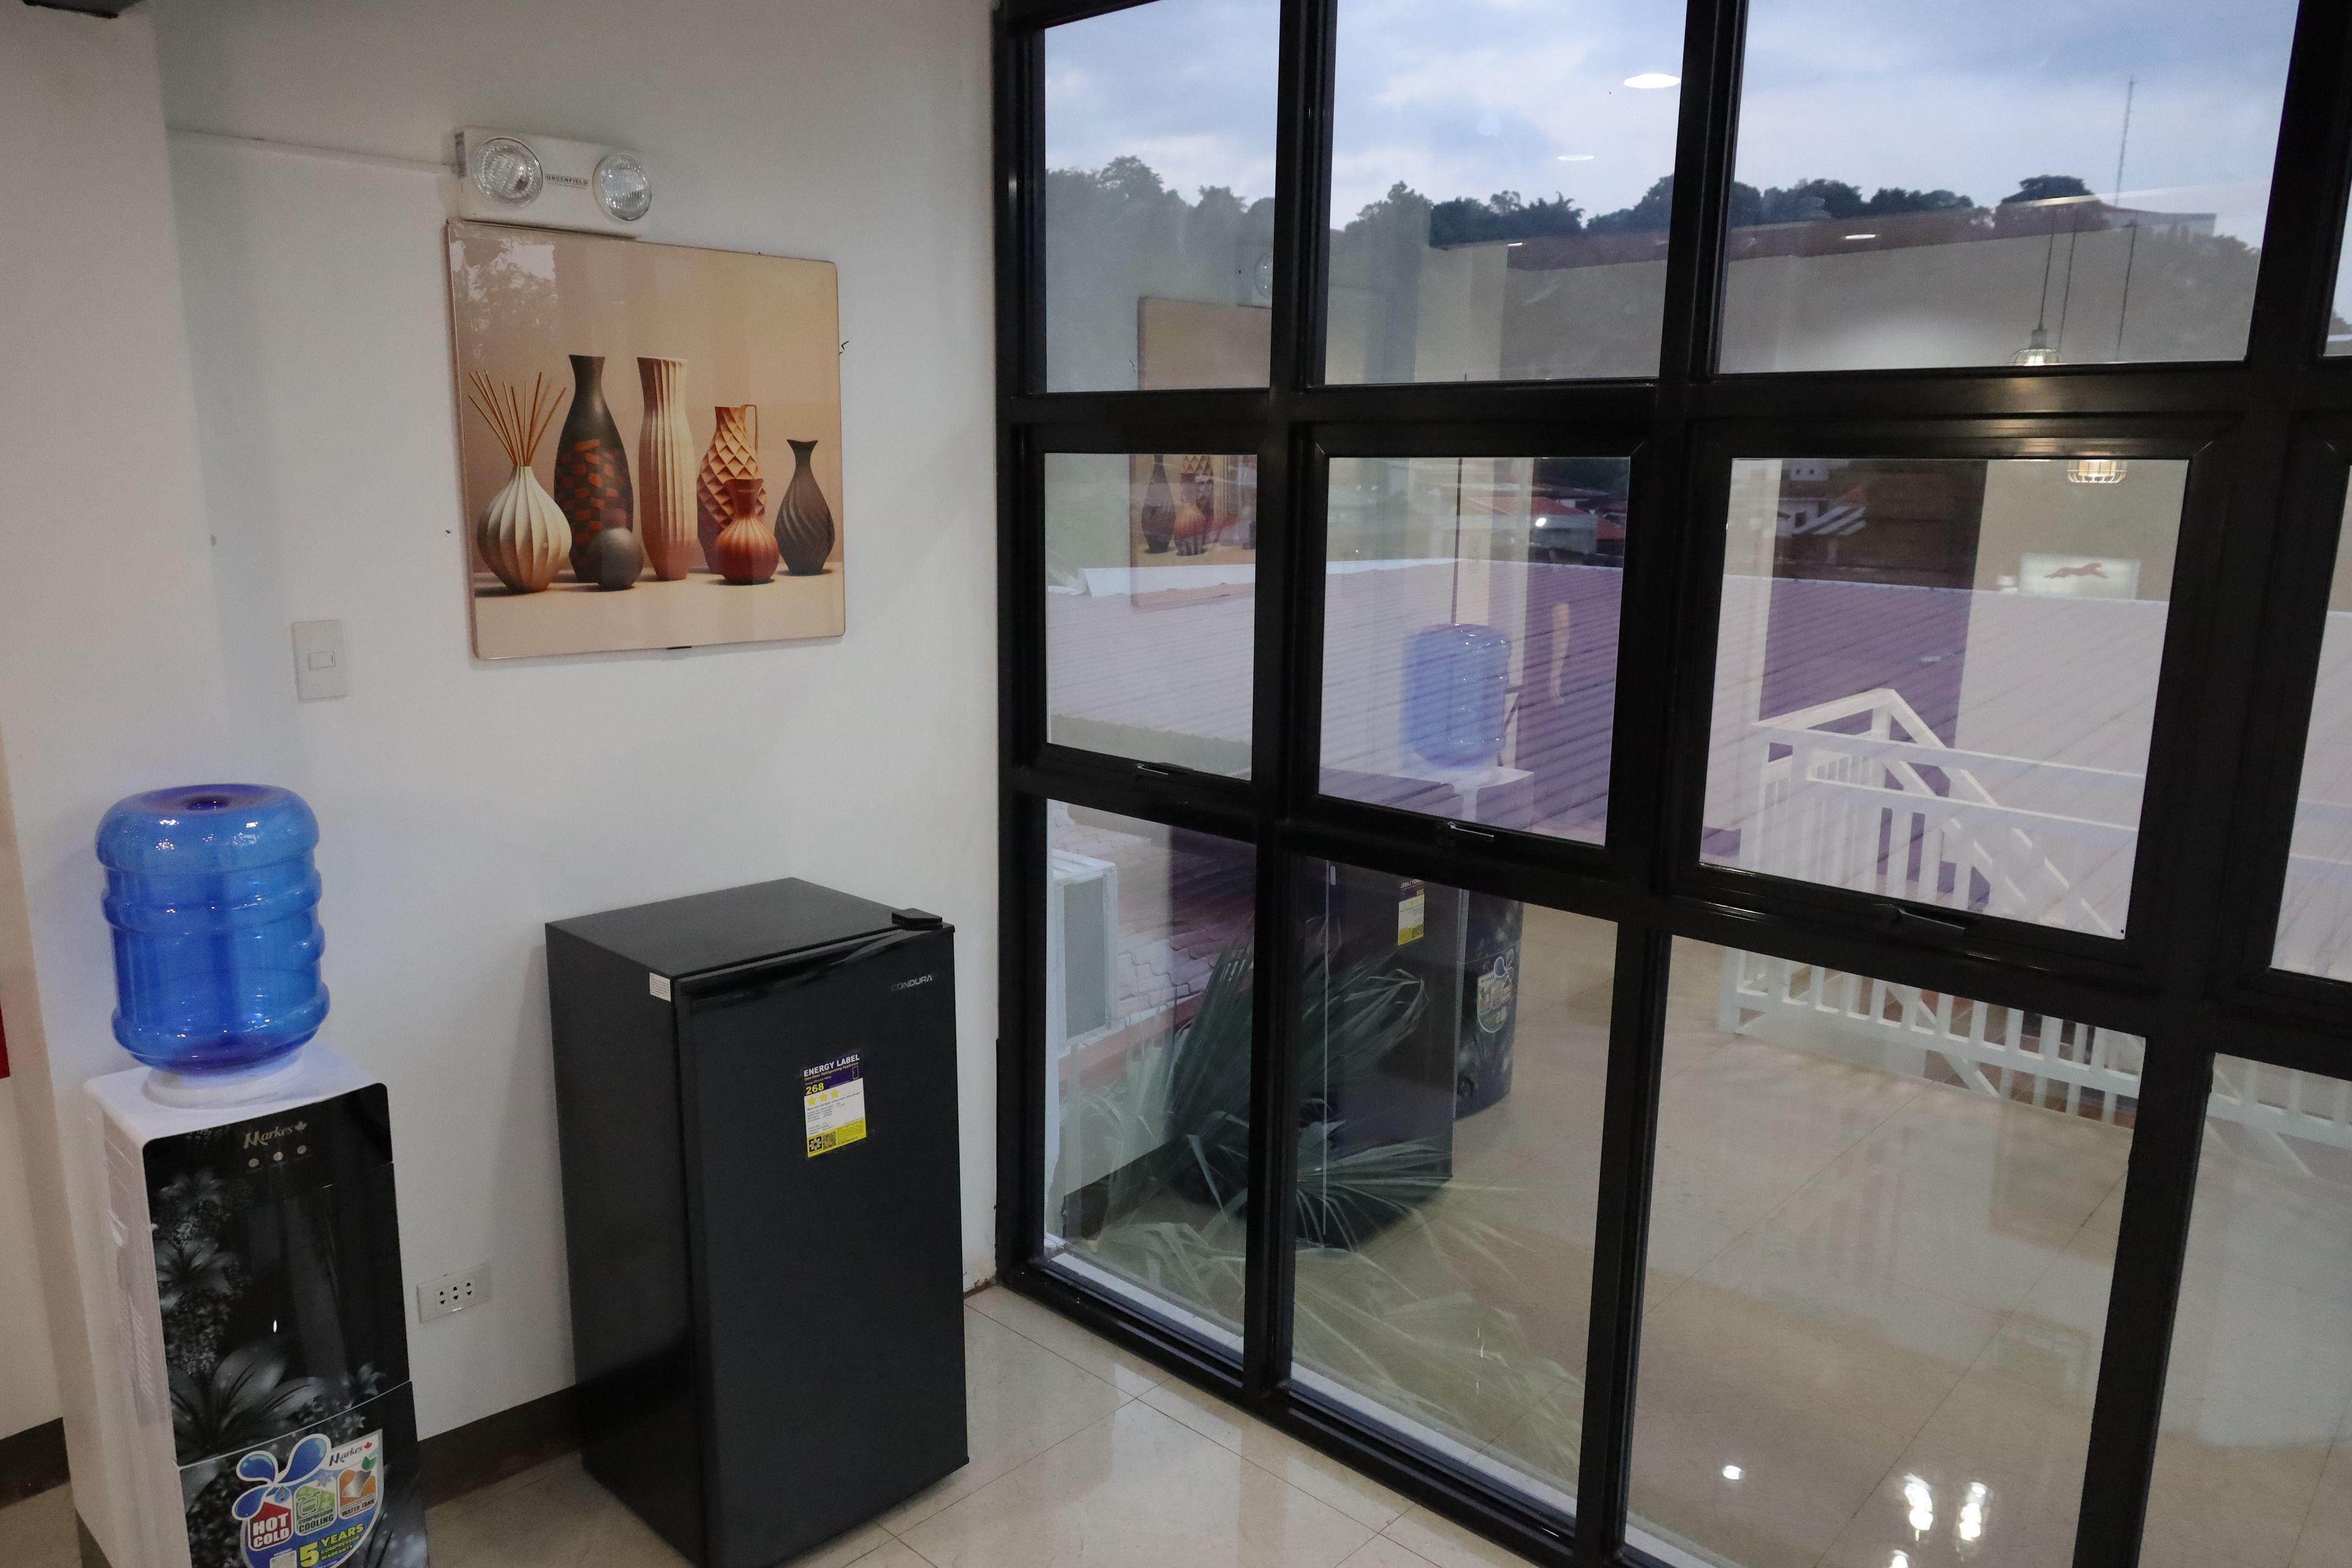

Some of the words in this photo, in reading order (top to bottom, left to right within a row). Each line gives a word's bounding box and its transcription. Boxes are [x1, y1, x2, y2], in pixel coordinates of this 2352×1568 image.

[546, 175, 588, 186] GREENFIELD
[891, 974, 933, 991] CONDURA
[804, 1061, 835, 1077] ENERGY
[836, 1054, 860, 1067] LABEL
[805, 1082, 824, 1096] 268
[244, 1126, 293, 1149] Markes
[329, 1446, 363, 1467] Markes
[342, 1505, 360, 1517] WATER
[252, 1512, 289, 1537] HOT
[299, 1513, 334, 1533] COOLING
[253, 1528, 290, 1548] COLD
[300, 1541, 320, 1568] 5
[320, 1523, 364, 1547] YEARS
